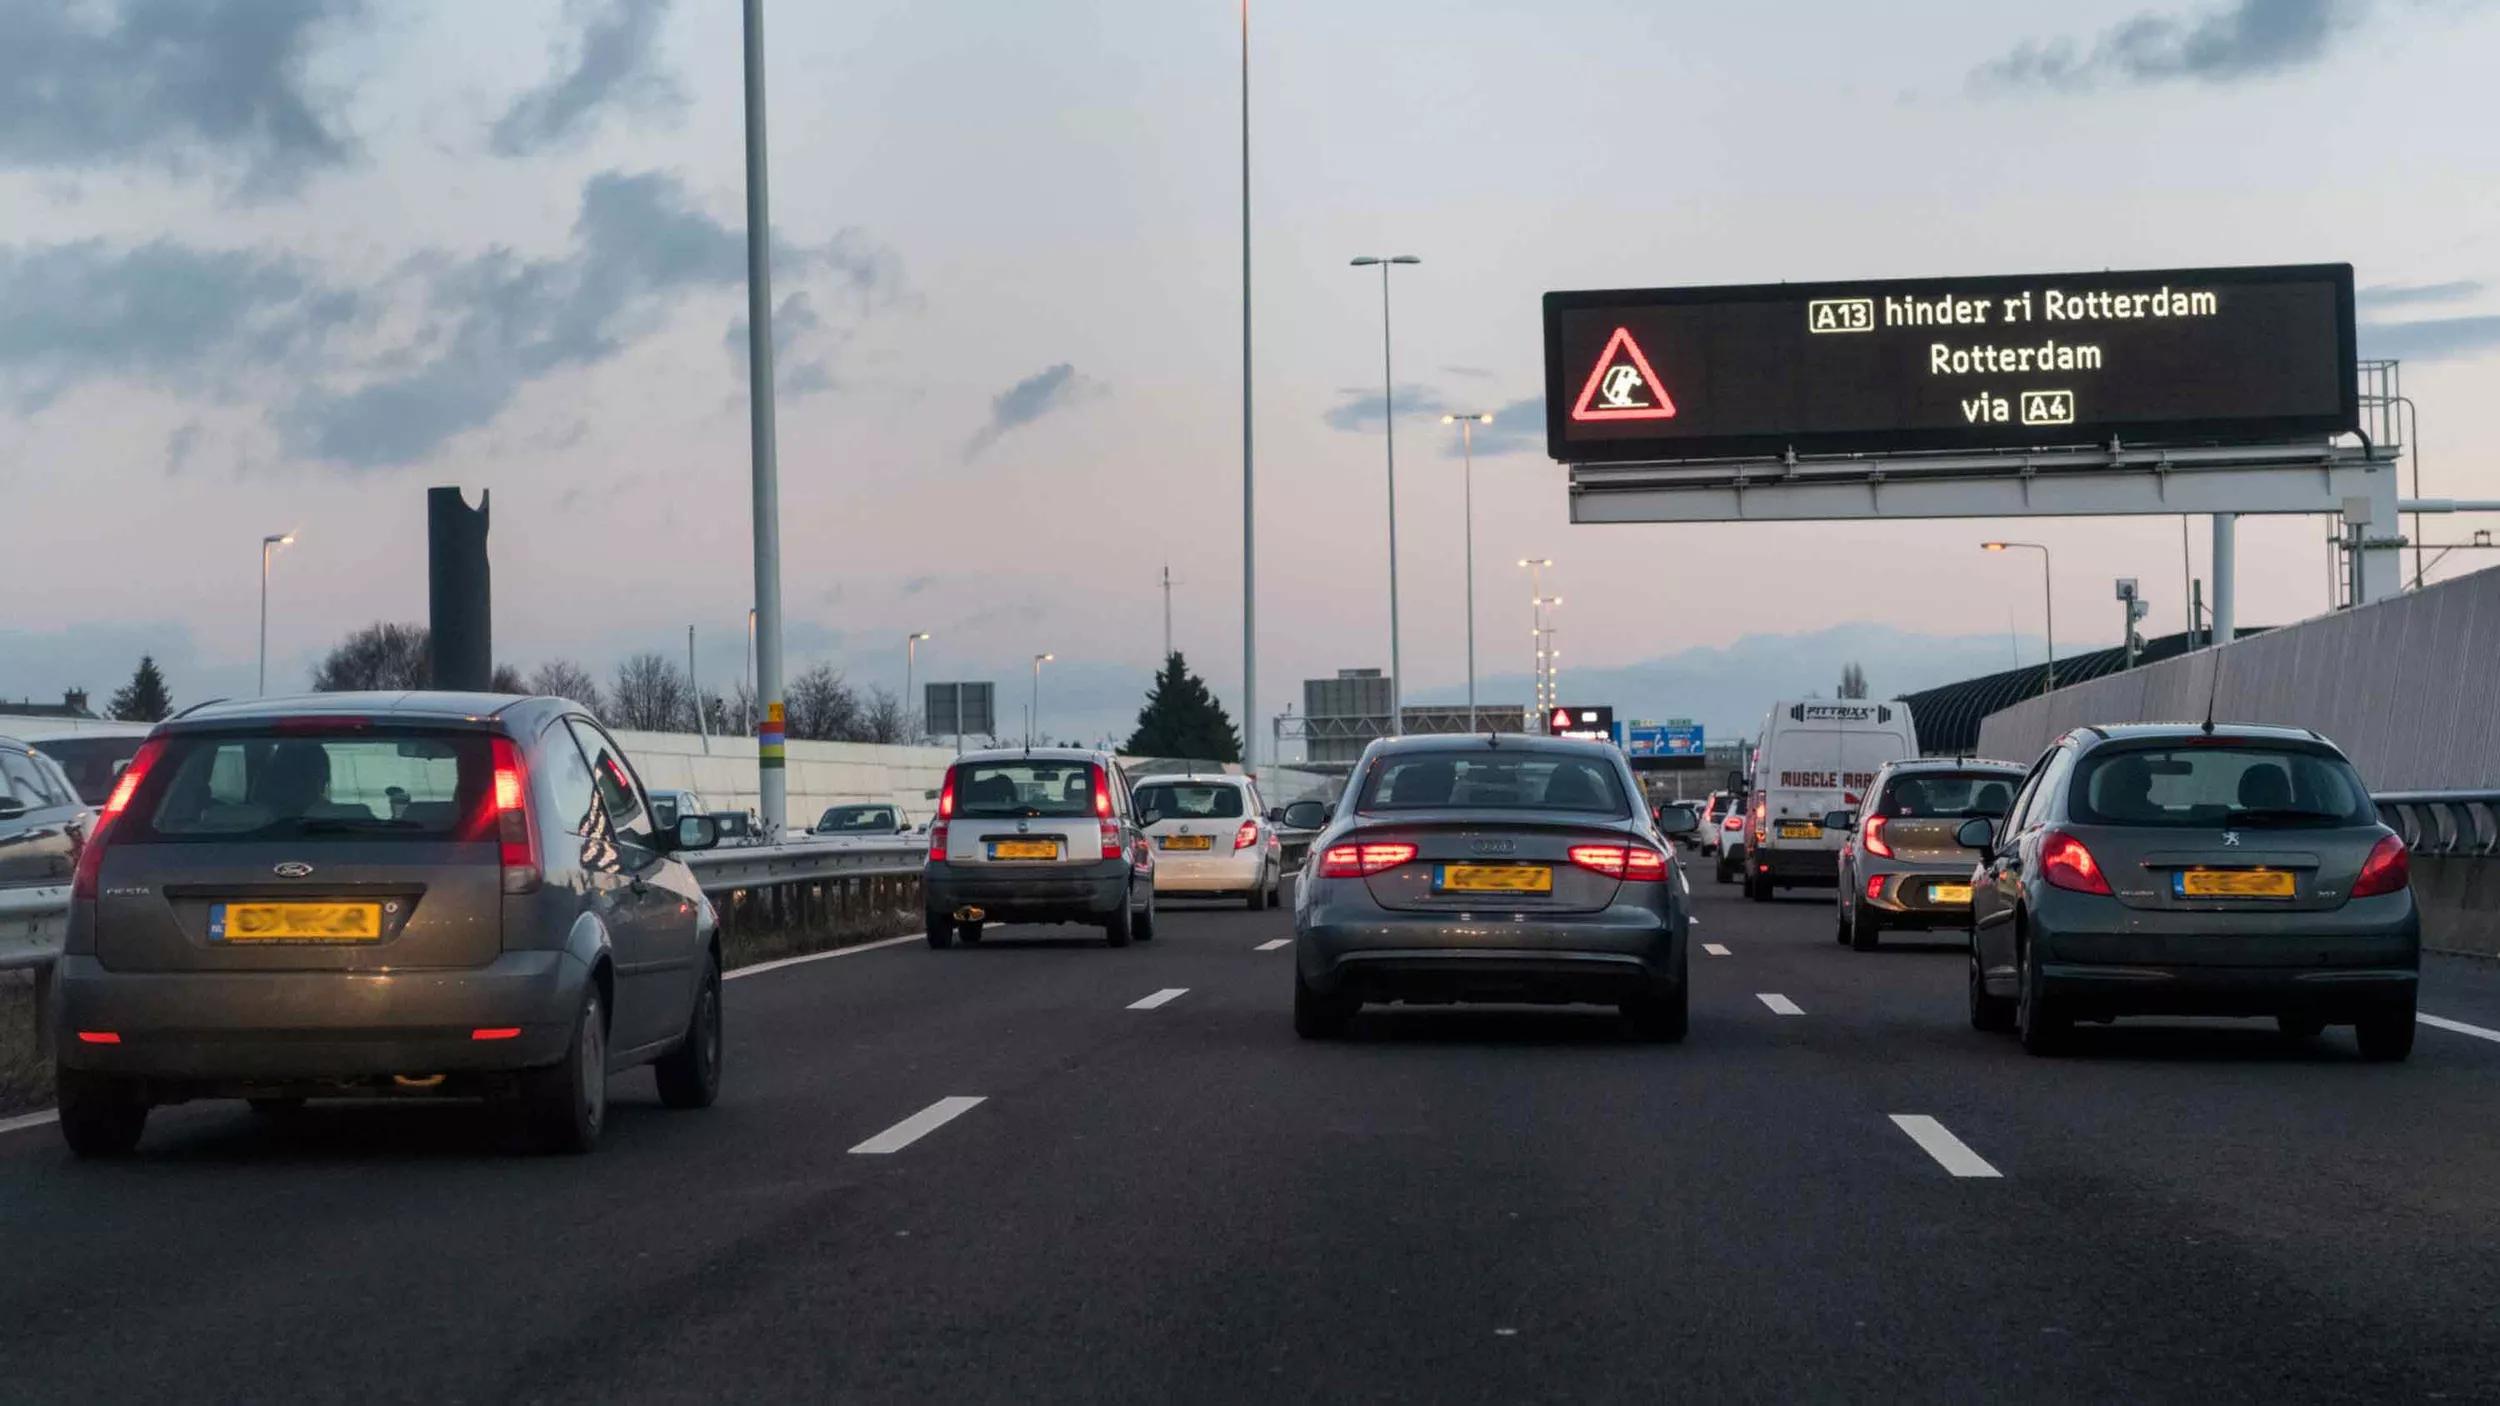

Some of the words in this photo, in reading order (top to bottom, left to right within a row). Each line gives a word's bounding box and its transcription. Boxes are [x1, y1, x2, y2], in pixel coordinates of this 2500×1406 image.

[1816, 303, 1867, 328] A13
[1886, 294, 1991, 326] hinder
[2003, 291, 2031, 322] ri
[2046, 286, 2216, 320] Rotterdam
[1931, 340, 2101, 374] Rotterdam
[1962, 392, 2009, 422] via
[2028, 395, 2067, 421] A4
[1781, 771, 1837, 788] MUSCLE
[1843, 772, 1879, 789] MAR
